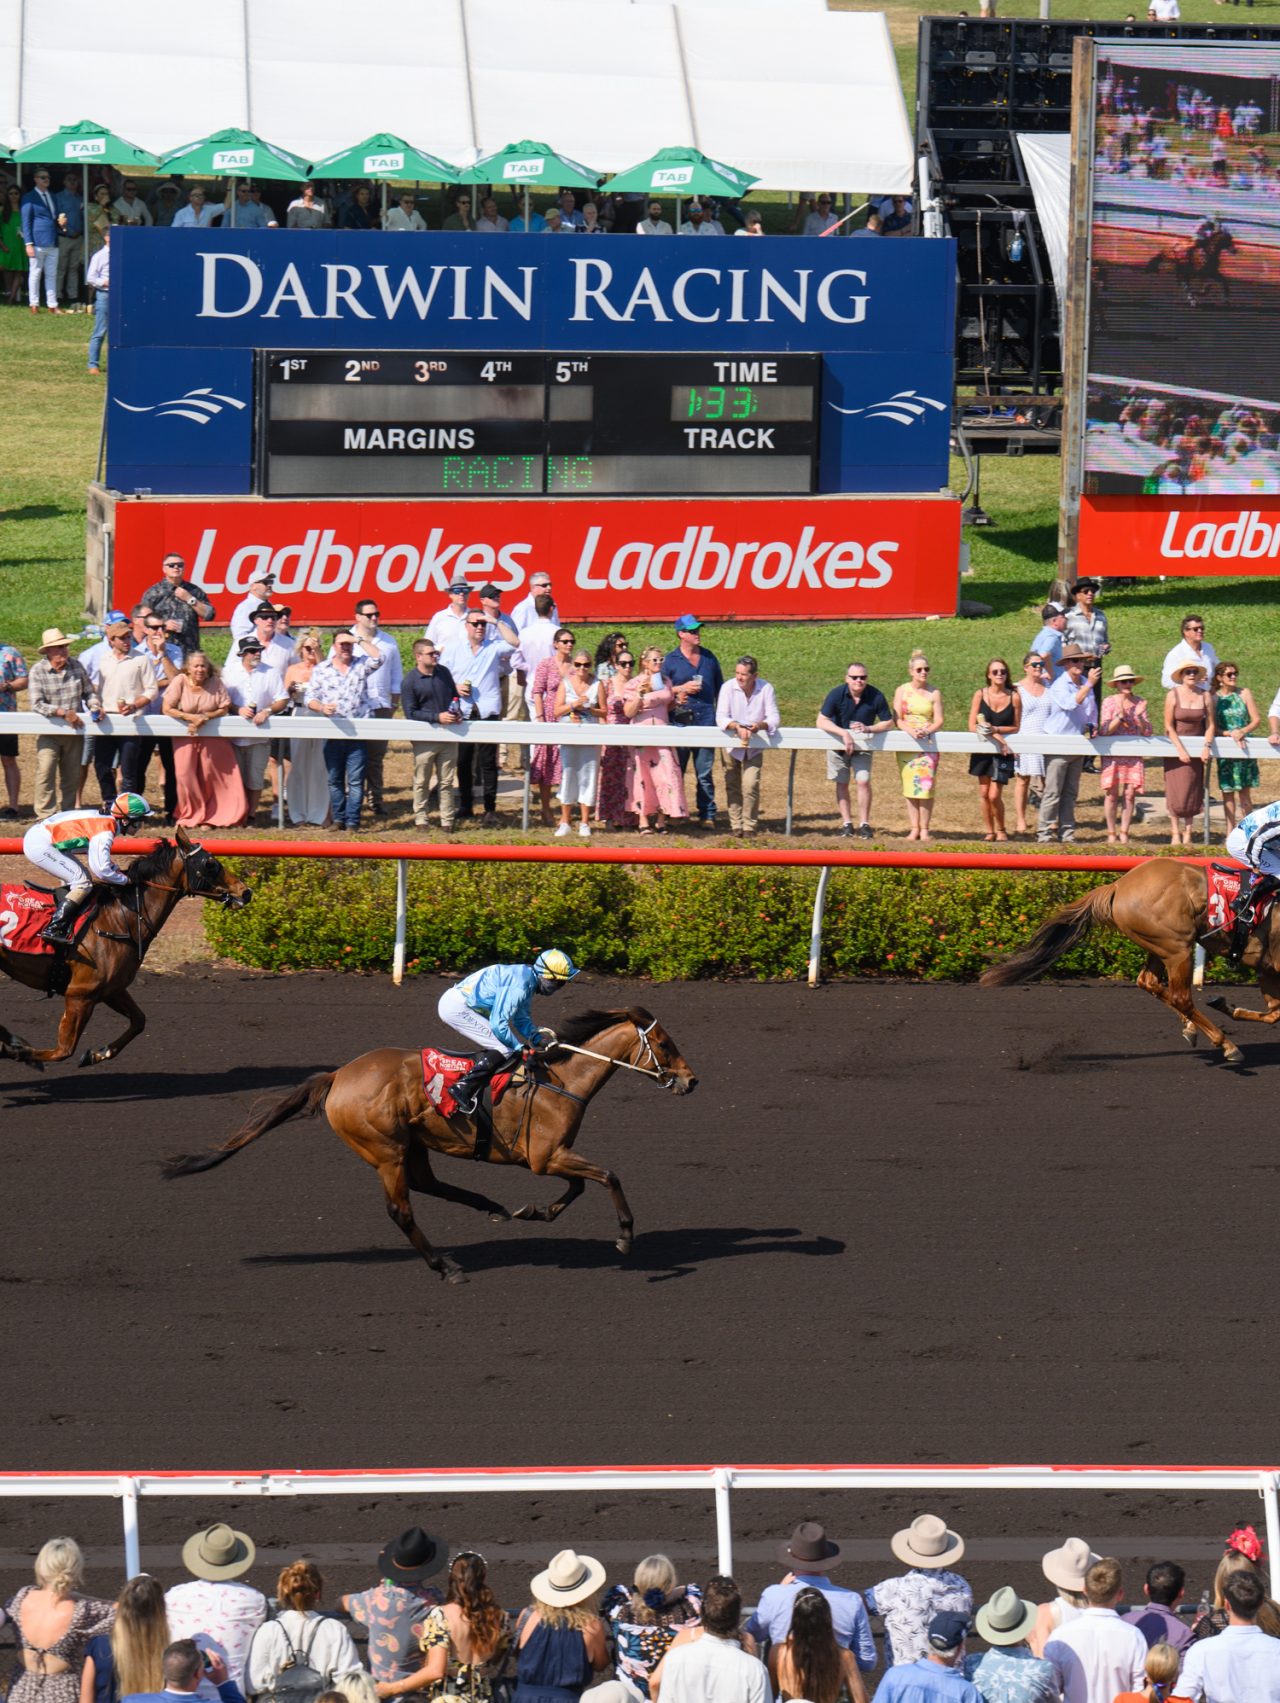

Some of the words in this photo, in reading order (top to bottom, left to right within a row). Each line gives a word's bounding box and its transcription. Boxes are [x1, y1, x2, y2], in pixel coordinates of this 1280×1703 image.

[70, 143, 101, 153] TAB
[219, 154, 249, 164] TAB
[370, 158, 400, 168] TAB
[509, 164, 540, 173] TAB
[658, 172, 688, 182] TAB
[195, 252, 539, 321] DARWIN
[567, 257, 872, 324] RACING
[279, 358, 308, 381] 1ST
[344, 359, 381, 382] 2ND
[413, 360, 448, 382] 3RD
[480, 360, 512, 382] 4TH
[555, 361, 588, 383] 5TH
[713, 361, 778, 383] TIME
[343, 428, 476, 450] MARGINS
[683, 428, 776, 449] TRACK
[442, 456, 593, 489] RACING
[190, 528, 533, 595] Ladbrokes
[574, 525, 900, 590] Ladbrokes
[1208, 893, 1226, 927] 3
[0, 910, 19, 947] 2
[426, 1072, 445, 1105] 4
